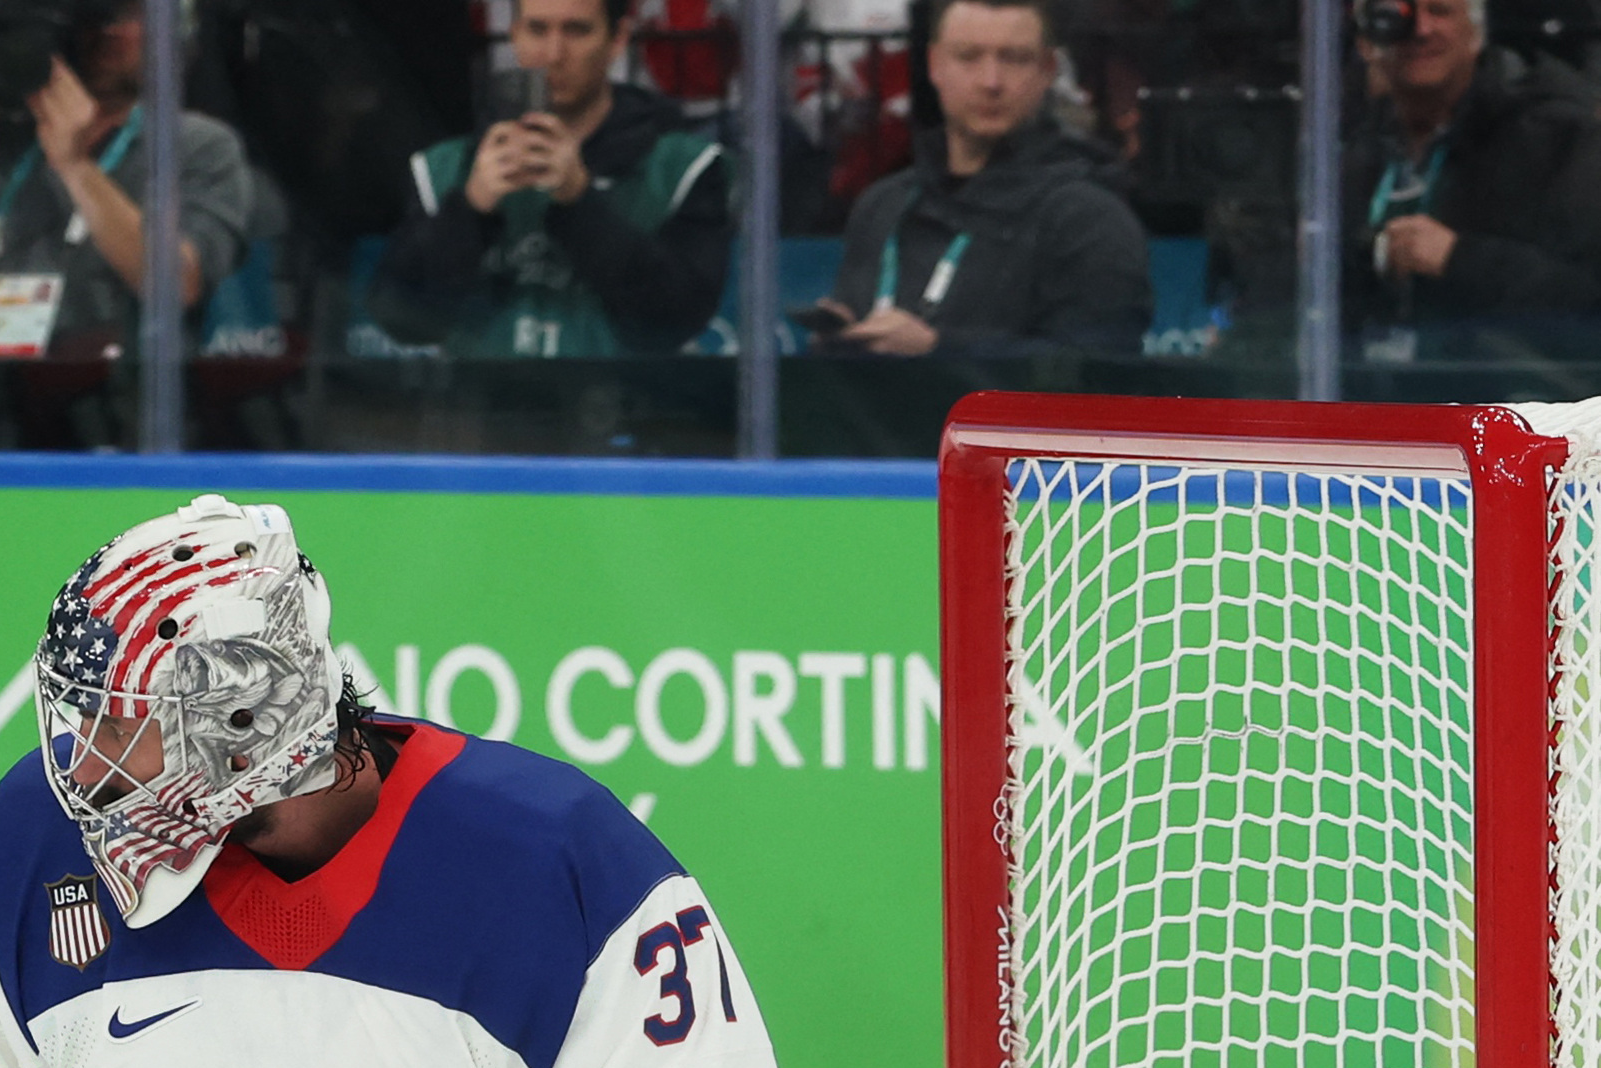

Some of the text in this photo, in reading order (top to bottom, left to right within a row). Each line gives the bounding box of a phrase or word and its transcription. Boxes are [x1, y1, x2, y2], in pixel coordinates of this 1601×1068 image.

[53, 883, 89, 906] USA
[633, 904, 737, 1047] 37
[997, 905, 1012, 1053] MILANO
